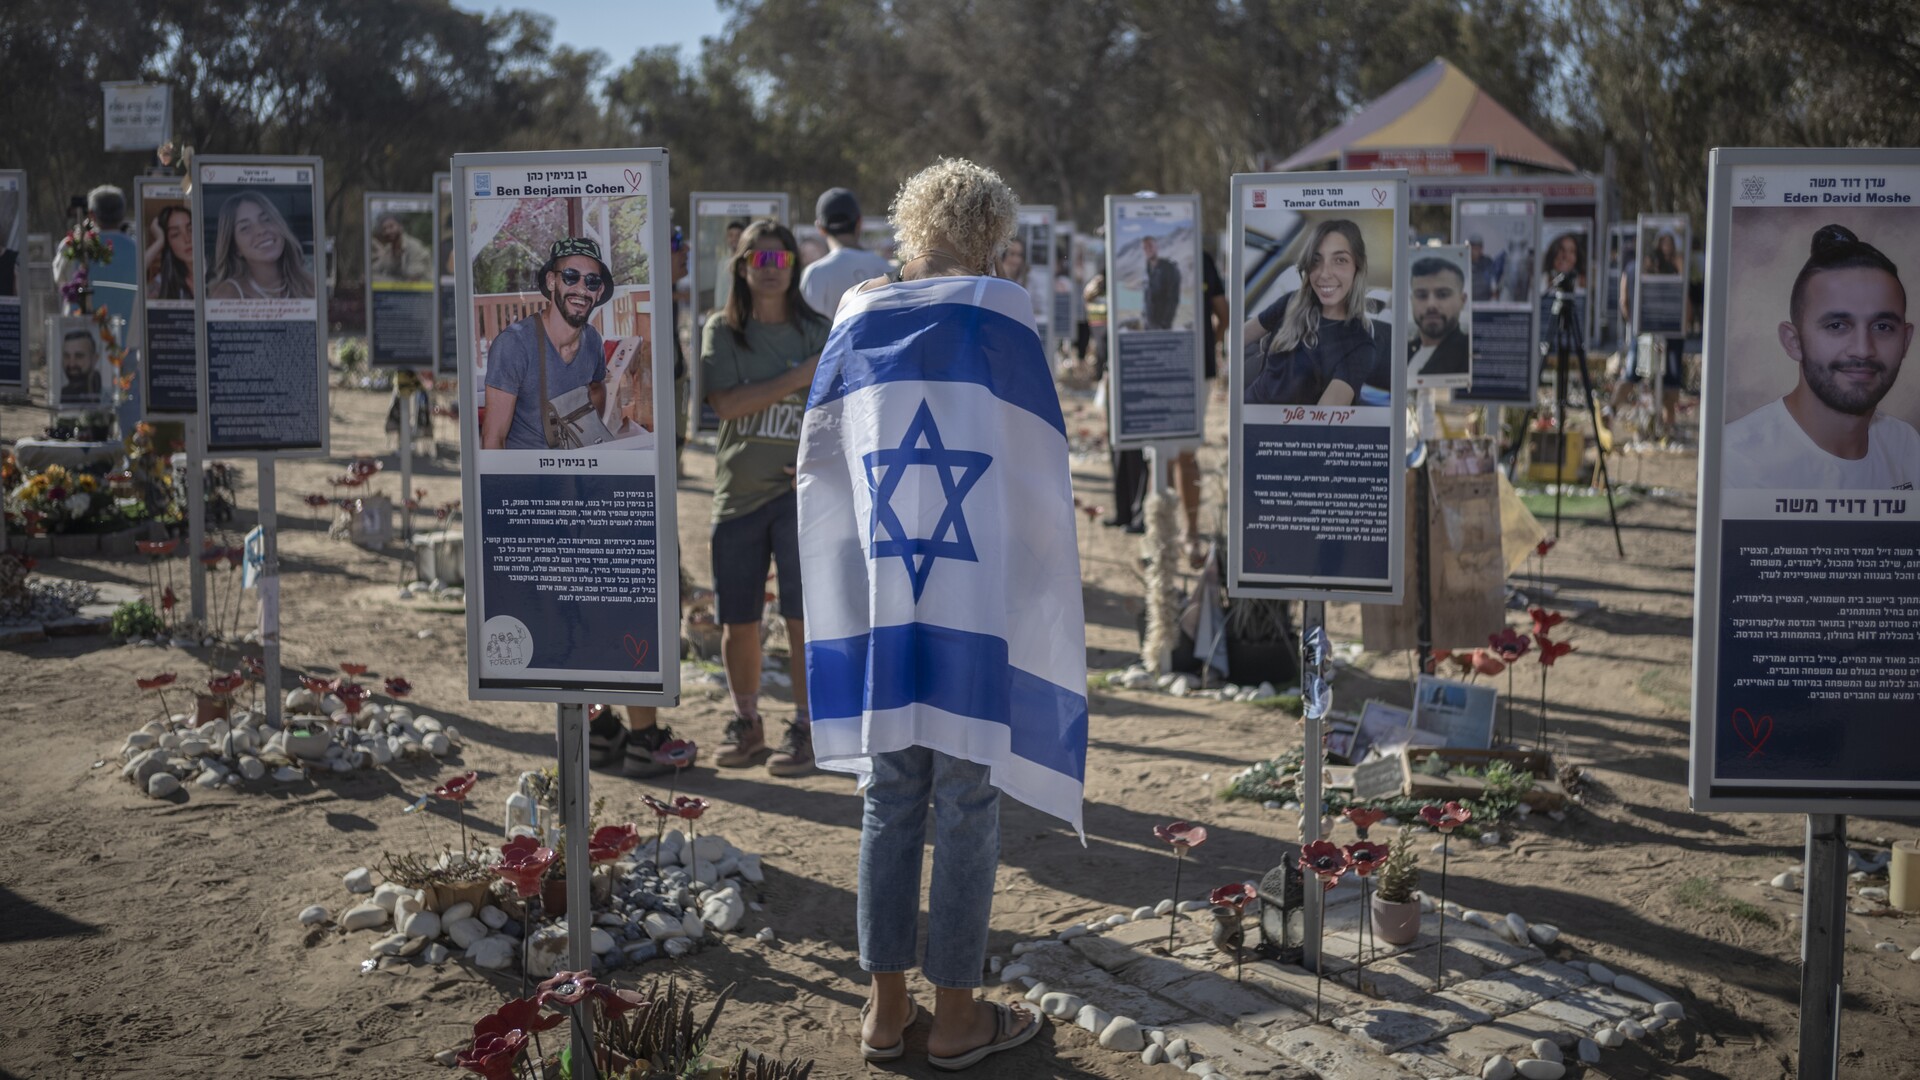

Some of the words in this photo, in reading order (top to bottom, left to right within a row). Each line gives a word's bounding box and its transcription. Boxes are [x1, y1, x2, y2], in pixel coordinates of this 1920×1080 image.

[526, 172, 543, 182] כהן
[545, 171, 574, 181] בנימין
[576, 170, 587, 181] בן
[1809, 178, 1836, 187] משה
[1840, 178, 1861, 187] דוד
[1864, 177, 1885, 189] עדן
[496, 186, 521, 196] Ben
[523, 184, 582, 198] Benjamin
[585, 183, 625, 194] Cohen
[1302, 188, 1324, 196] גוטמן
[1783, 192, 1818, 202] Eden
[1822, 192, 1861, 202] David
[1865, 192, 1911, 202] Moshe
[1282, 199, 1315, 207] Tamar
[1318, 198, 1359, 207] Gutman
[538, 458, 554, 468] כהן
[557, 458, 585, 468] בנימין
[587, 458, 598, 468] בן
[1775, 498, 1818, 512] משה
[1825, 498, 1866, 513] דויד
[1872, 499, 1906, 517] עדן
[1739, 546, 1768, 555] הצטיין
[1770, 545, 1808, 555] המושלם,
[1810, 545, 1831, 555] הילד
[1833, 547, 1849, 555] היה
[1851, 547, 1874, 555] תמיד
[1750, 558, 1782, 566] משפחה
[1783, 558, 1821, 567] לימודים,
[1823, 558, 1854, 568] מהכול,
[1856, 558, 1876, 567] הכול
[1878, 558, 1900, 567] שילב
[1757, 569, 1781, 579] לעדן.
[1782, 571, 1826, 579] שאופיינית
[1828, 571, 1861, 579] וצניעות
[1894, 571, 1914, 579] והכל
[1732, 593, 1773, 603] בלימודיו,
[1774, 595, 1803, 603] הצטיין
[1805, 595, 1845, 604] חשמונאי,
[1883, 606, 1904, 615] בחיל
[1817, 619, 1845, 627] בתואר
[1847, 620, 1876, 628] מצטיין
[1733, 630, 1763, 638] הנדסה.
[1780, 631, 1821, 639] בהתמחות
[1823, 630, 1854, 640] בחולון,
[1856, 630, 1877, 639] HIT
[1879, 631, 1914, 639] במכללת
[1752, 654, 1786, 663] אמריקה
[1817, 654, 1836, 663] טייל
[1838, 656, 1867, 664] החיים,
[1766, 666, 1799, 674] וחברים.
[1801, 667, 1833, 675] משפחה
[1835, 667, 1847, 675] עם
[1850, 666, 1876, 675] בעולם
[1733, 678, 1774, 687] האחיינים,
[1824, 679, 1862, 687] המשפחה
[1878, 678, 1905, 687] לבלות
[1807, 691, 1840, 699] הטובים.
[1843, 691, 1875, 699] החברים
